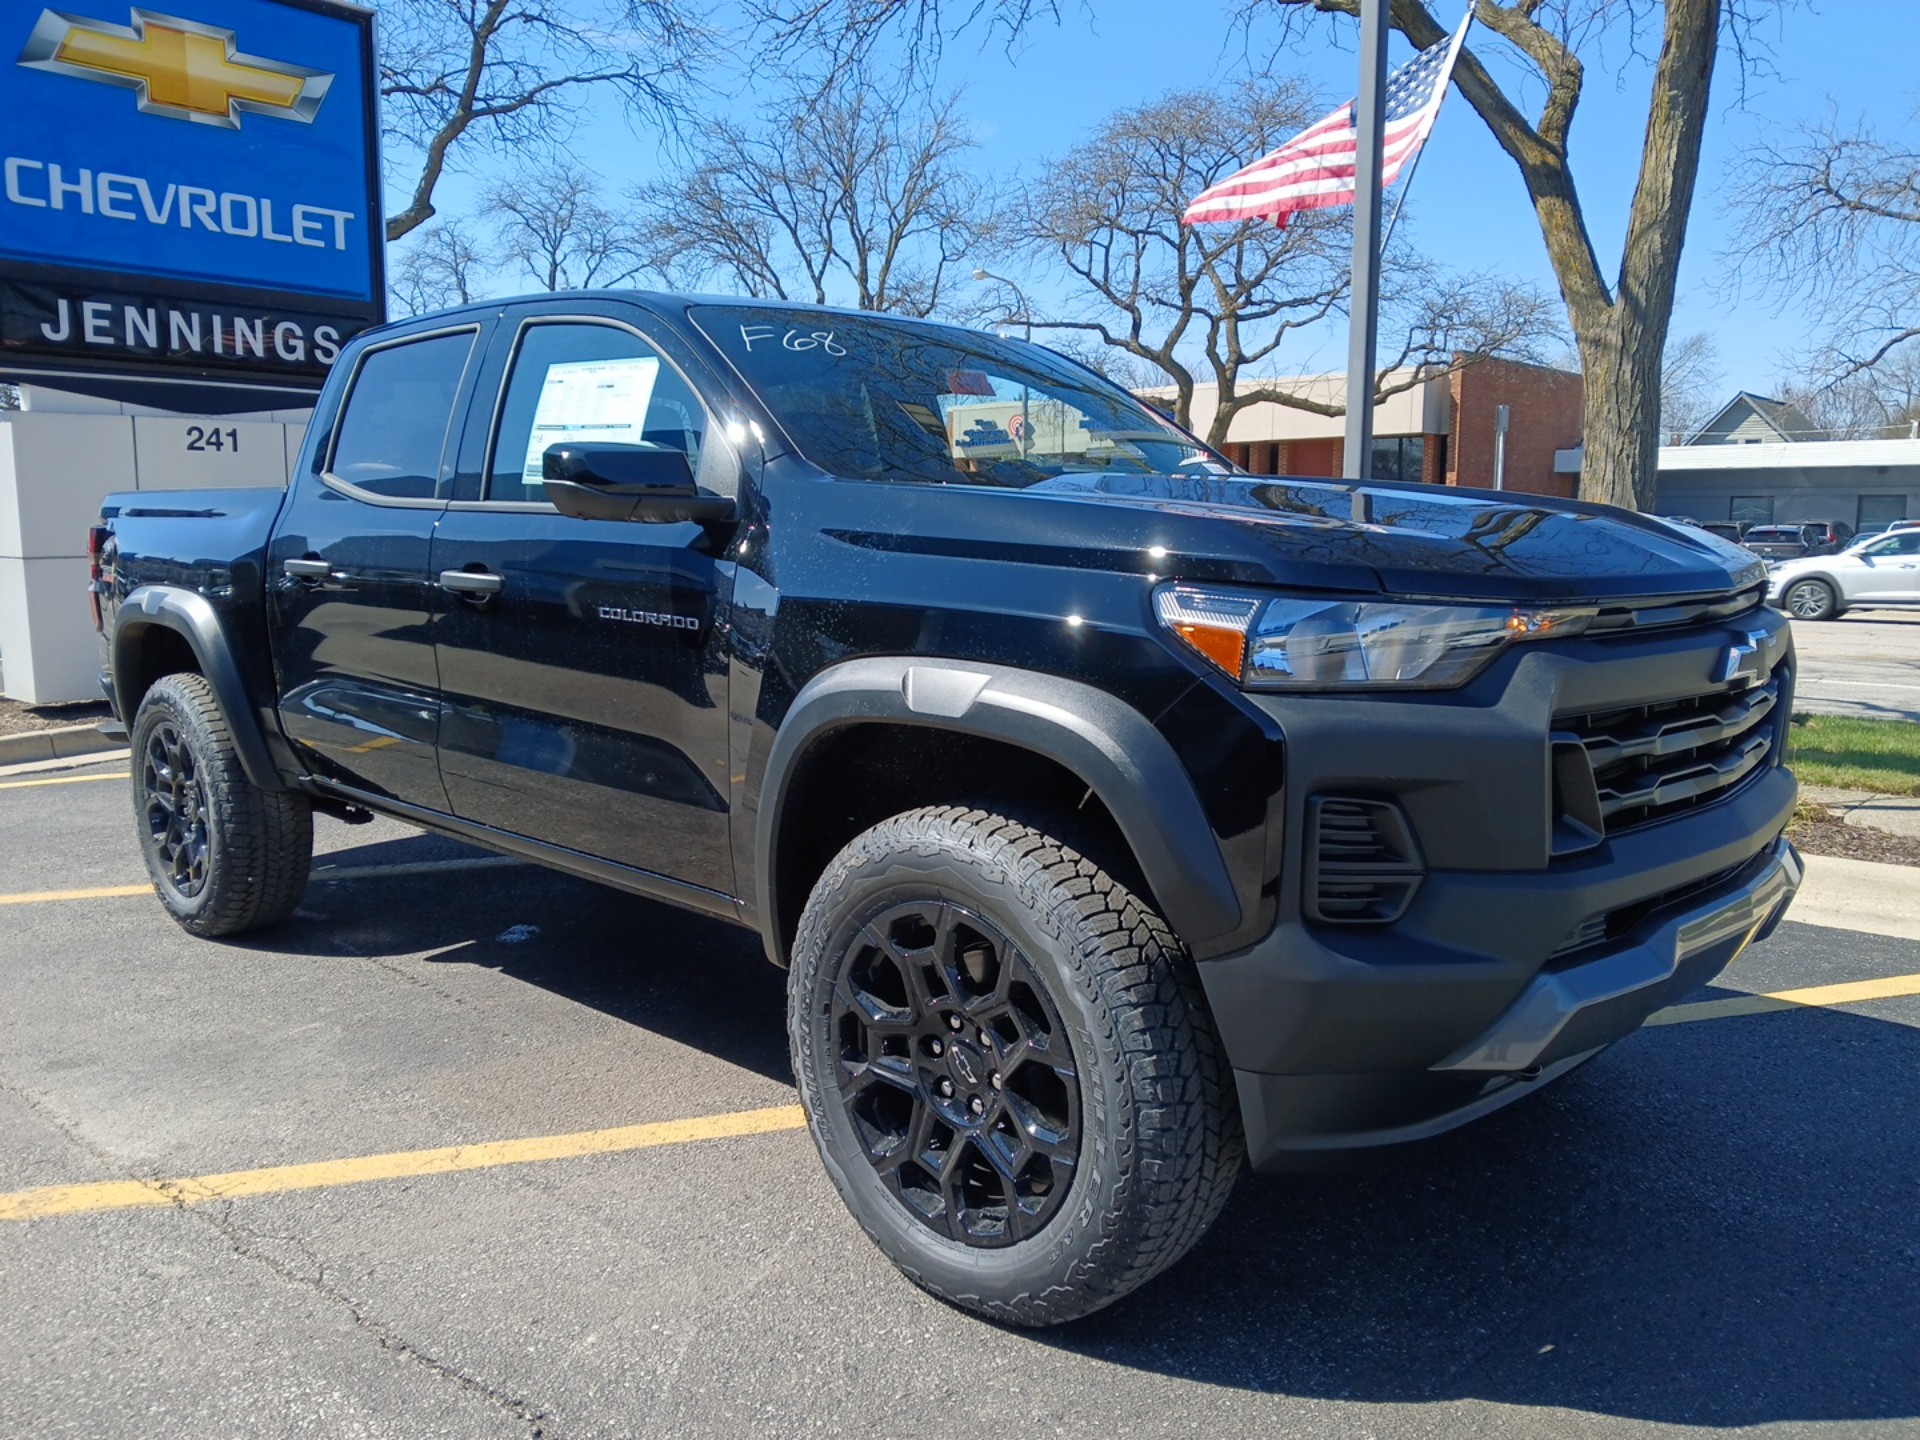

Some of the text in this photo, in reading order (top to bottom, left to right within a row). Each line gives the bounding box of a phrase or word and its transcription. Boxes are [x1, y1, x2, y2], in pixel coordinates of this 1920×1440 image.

[4, 156, 355, 251] CHEVROLET
[40, 297, 341, 366] JENNINGS
[186, 426, 239, 453] 241
[598, 606, 700, 631] COLORADO
[800, 919, 833, 1143] BRIDGESTONE
